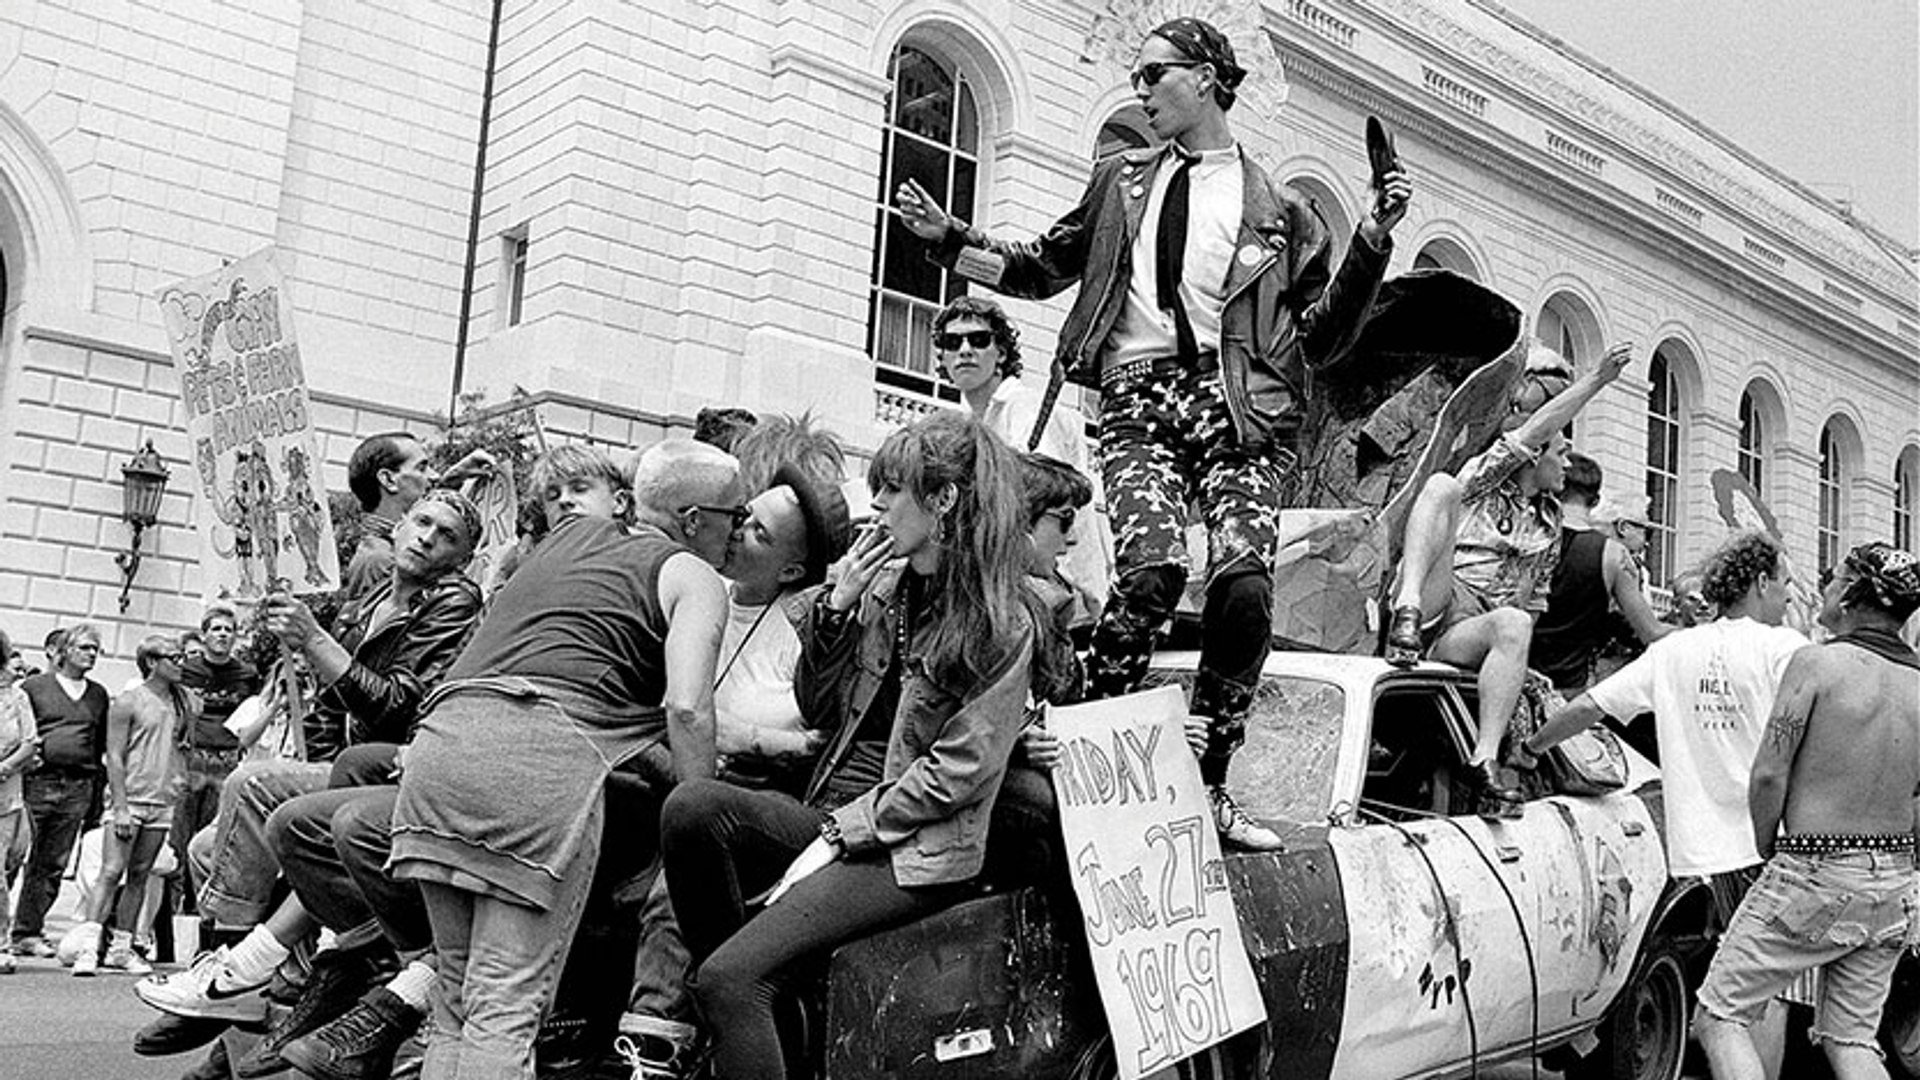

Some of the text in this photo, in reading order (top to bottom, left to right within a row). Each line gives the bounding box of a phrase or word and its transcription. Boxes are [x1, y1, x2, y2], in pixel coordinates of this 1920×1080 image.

[212, 387, 308, 457] ANIMALS
[1055, 724, 1176, 806] RIDAY,
[1077, 842, 1158, 947] JUNE
[1116, 927, 1232, 1074] 1969
